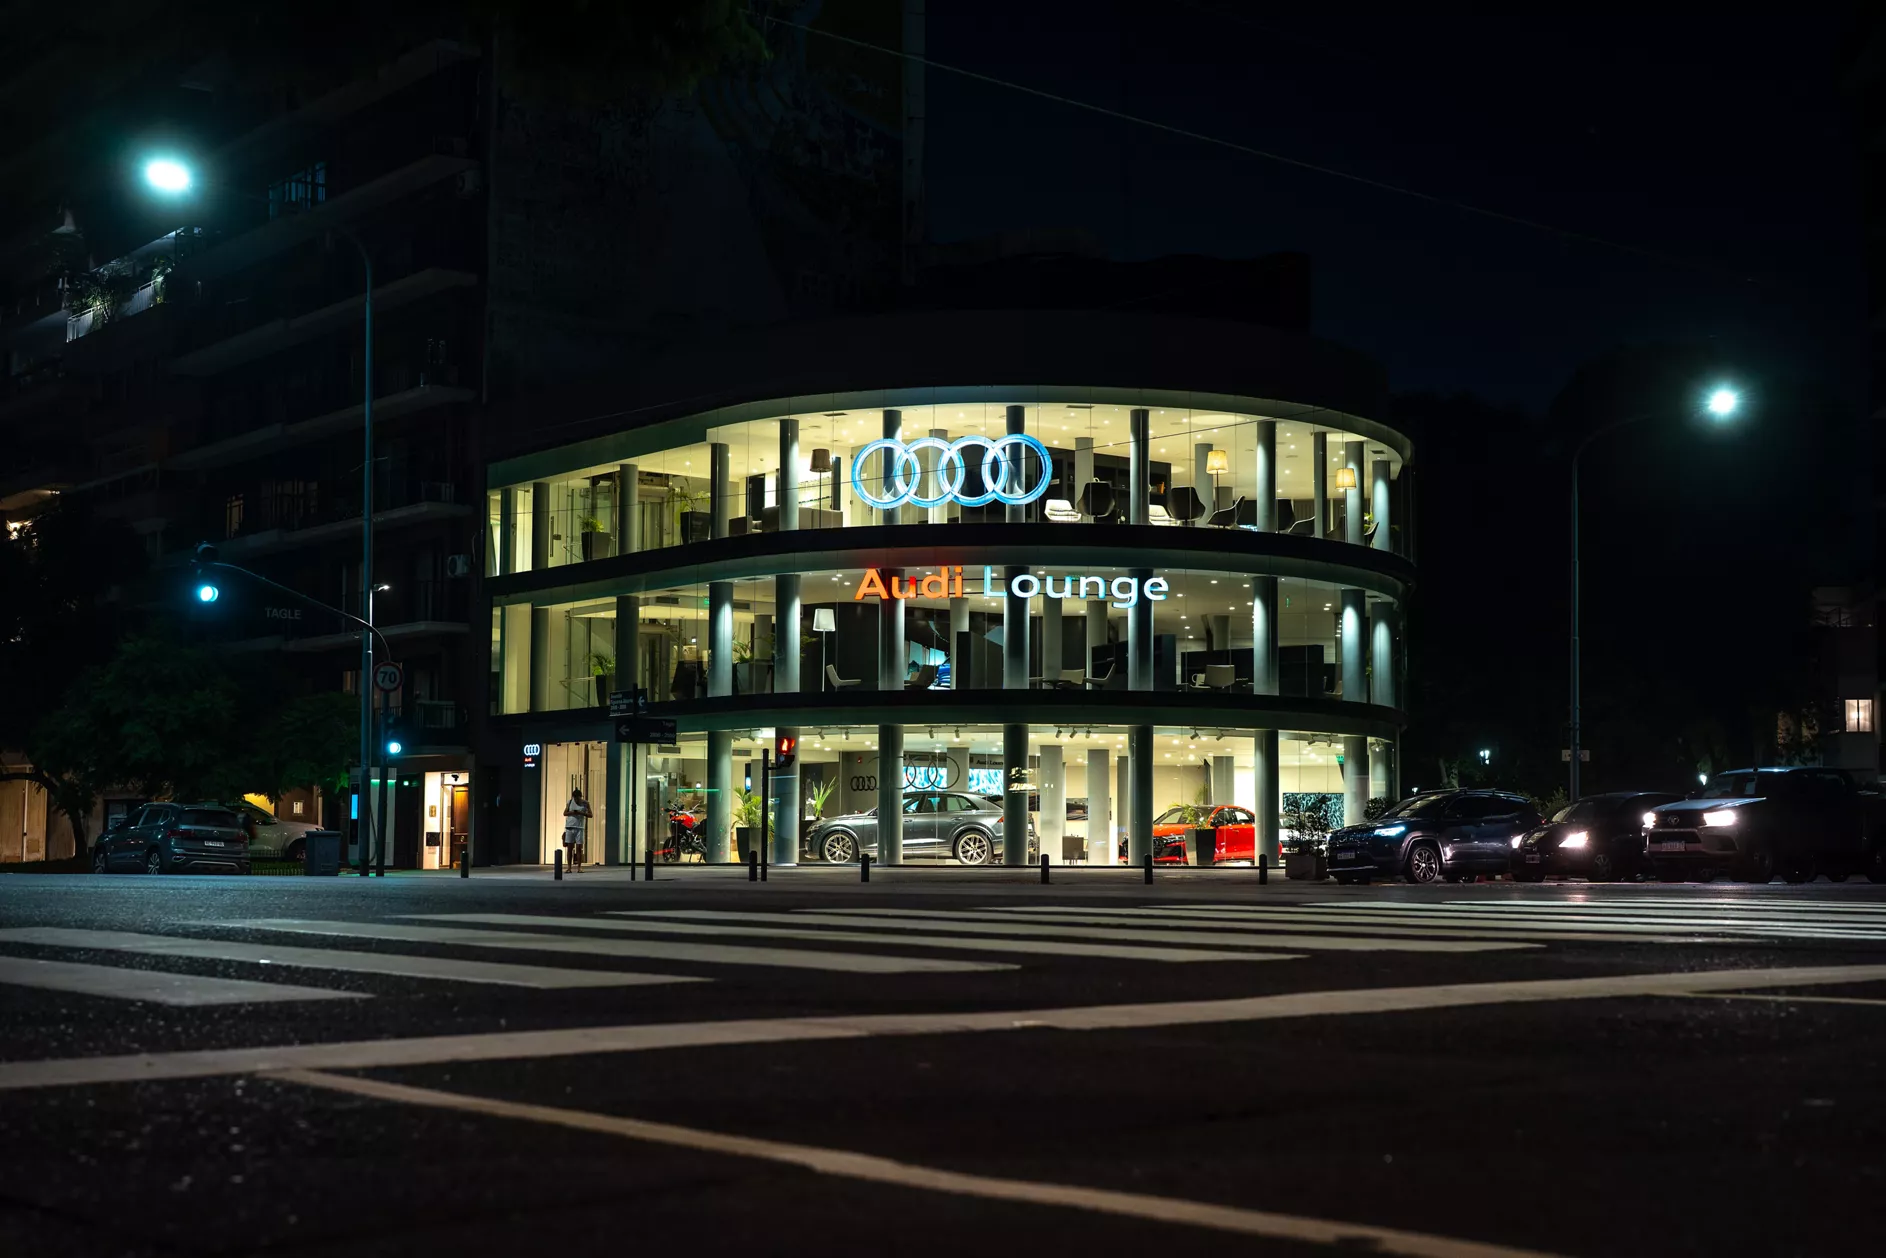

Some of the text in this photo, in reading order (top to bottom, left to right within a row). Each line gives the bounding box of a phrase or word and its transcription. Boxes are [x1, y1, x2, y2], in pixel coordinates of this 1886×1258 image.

[854, 565, 1169, 609] Audi Lounge
[265, 606, 302, 620] TAGLE
[380, 671, 396, 683] 70
